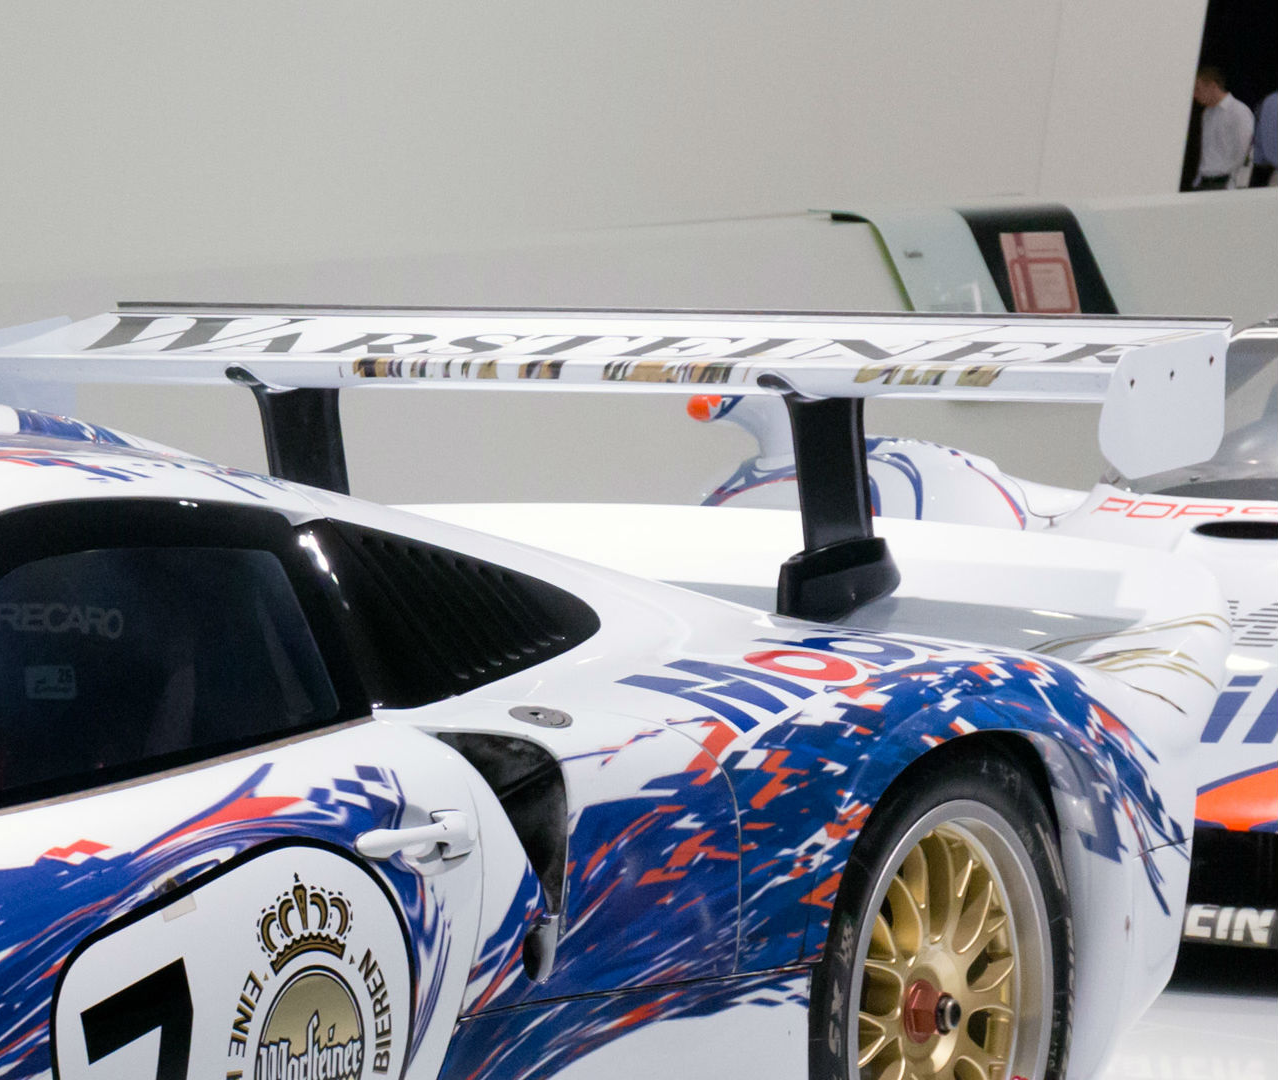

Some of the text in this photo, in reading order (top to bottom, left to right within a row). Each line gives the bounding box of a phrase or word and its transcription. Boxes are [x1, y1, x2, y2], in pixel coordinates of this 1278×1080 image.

[227, 969, 264, 1058] EINE
[357, 947, 393, 1075] BIEREN
[828, 981, 845, 1058] SX
